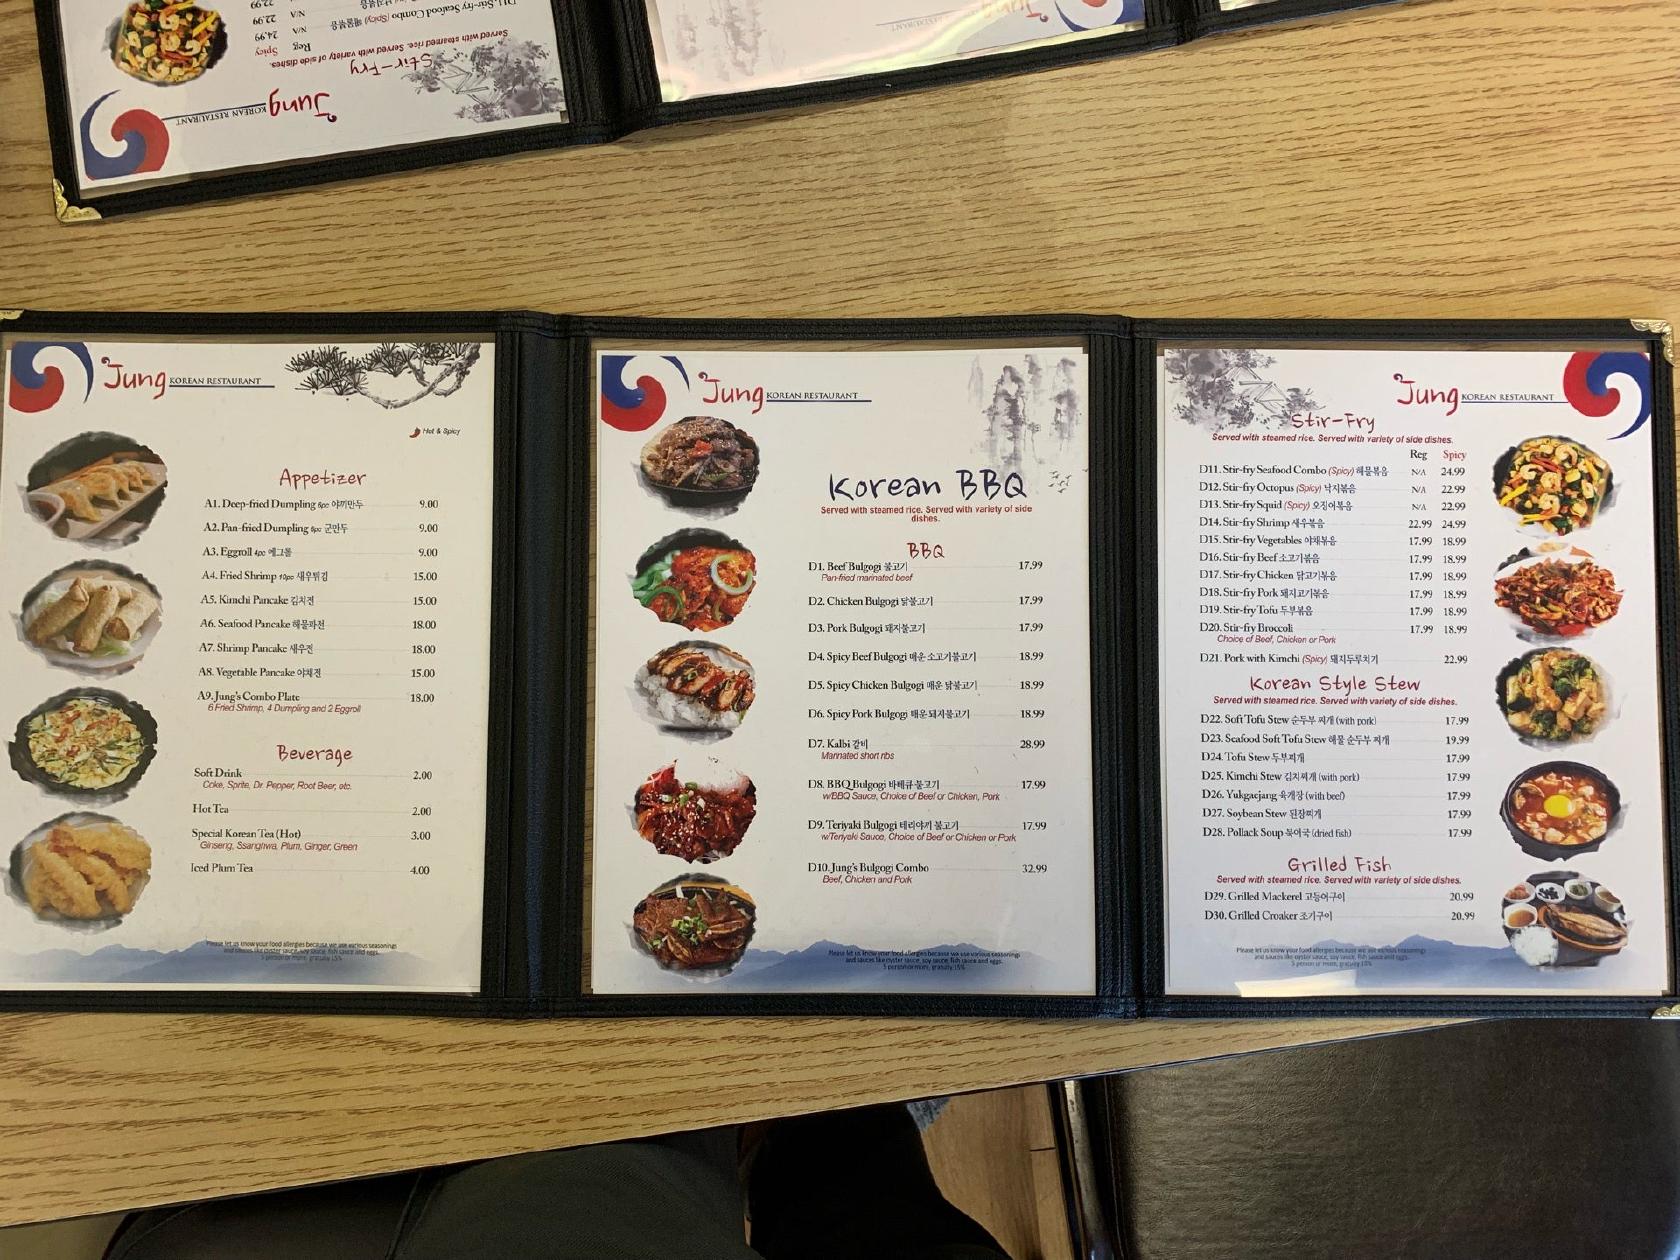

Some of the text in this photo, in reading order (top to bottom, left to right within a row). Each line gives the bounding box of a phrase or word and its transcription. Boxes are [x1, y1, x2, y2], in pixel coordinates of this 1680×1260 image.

[253, 15, 276, 25] 22.99
[255, 5, 460, 41] Seafood Combo (Spicy) N/A 24.99
[462, 34, 479, 42] with
[480, 30, 509, 41] Served
[407, 41, 424, 49] rice.
[426, 37, 459, 47] steamed
[254, 42, 311, 57] Reg Spicy
[358, 48, 374, 57] with
[377, 44, 404, 54] Served
[269, 57, 298, 68] dishes.
[300, 57, 316, 65] side
[329, 51, 355, 62] variety
[350, 53, 432, 76] Stir-Fry
[176, 88, 337, 126] Jung KOREAN RESTAURANT
[101, 357, 165, 399] Jung
[698, 372, 763, 414] Jung
[1393, 373, 1554, 416] Jung KOREAN RESTAURANT
[1292, 413, 1375, 433] Stir-Fry
[443, 428, 460, 436] Spicy
[1411, 449, 1467, 461] Reg Spicy
[1257, 465, 1291, 473] Seafood
[1293, 465, 1326, 474] Combo
[1328, 467, 1354, 476] (Spicy)
[1441, 467, 1465, 476] 24.99
[280, 469, 366, 490] Appetizer
[830, 469, 1027, 501] Korean BBQ
[1257, 482, 1294, 494] Octopus
[1296, 484, 1321, 493] (Spicy)
[1442, 485, 1465, 493] 22.99
[205, 499, 438, 511] A1. Deep-fried Dumpling 9.00
[821, 506, 848, 514] Served
[870, 506, 904, 514] steamed
[906, 506, 923, 514] rice.
[925, 506, 953, 514] Served
[976, 505, 1002, 514] variety
[1200, 500, 1221, 508] D13.
[1223, 500, 1255, 511] Stir-fry
[1256, 500, 1282, 512] Squid
[1442, 502, 1465, 510] 22.99
[911, 514, 941, 522] dishes.
[1200, 517, 1466, 529] D14. Stir-fry Shrimp 22.99 24.99
[204, 522, 438, 535] A2. Pan-fried Dumpling 9.00
[203, 547, 218, 556] A3.
[221, 547, 252, 558] Eggroll
[907, 543, 944, 559] BBQ
[809, 562, 826, 571] D1.
[827, 562, 847, 571] Beef
[849, 562, 881, 574] Bulgogi
[1020, 561, 1042, 569] 17.99
[202, 571, 437, 583] A4. Fried Shrimp 15.00
[827, 596, 1043, 608] Chicken Bulgogi 17.99
[809, 623, 1043, 634] D3. Pork Bulgogi 17.99
[809, 652, 1043, 663] D4. Spicy Beef Bulgogi 18.99
[1225, 654, 1467, 663] Pork with Kimchi 22.99
[199, 667, 435, 679] A8. Vegetable Pancake 15.00
[1251, 675, 1420, 697] Korean Style Stew
[242, 692, 434, 703] Combo Plate 18.00
[1225, 714, 1469, 725] Soft Tofu Stew 17.99
[828, 739, 850, 748] Kalbi
[1020, 740, 1045, 748] 28.99
[277, 745, 352, 767] Beverage
[194, 768, 432, 780] Soft Drink 2.00
[193, 804, 431, 815] Hot Tea 2.00
[1227, 809, 1471, 821] Soybean Stew 17.99
[192, 829, 430, 841] Special Korean Tea (Hot) 3.00
[191, 863, 429, 875] Iced Plum Tea 4.00
[860, 863, 1047, 875] Bulgogi Combo 32.99
[1288, 856, 1391, 872] Grilled Fish
[1262, 892, 1473, 901] Mackerel 20.99
